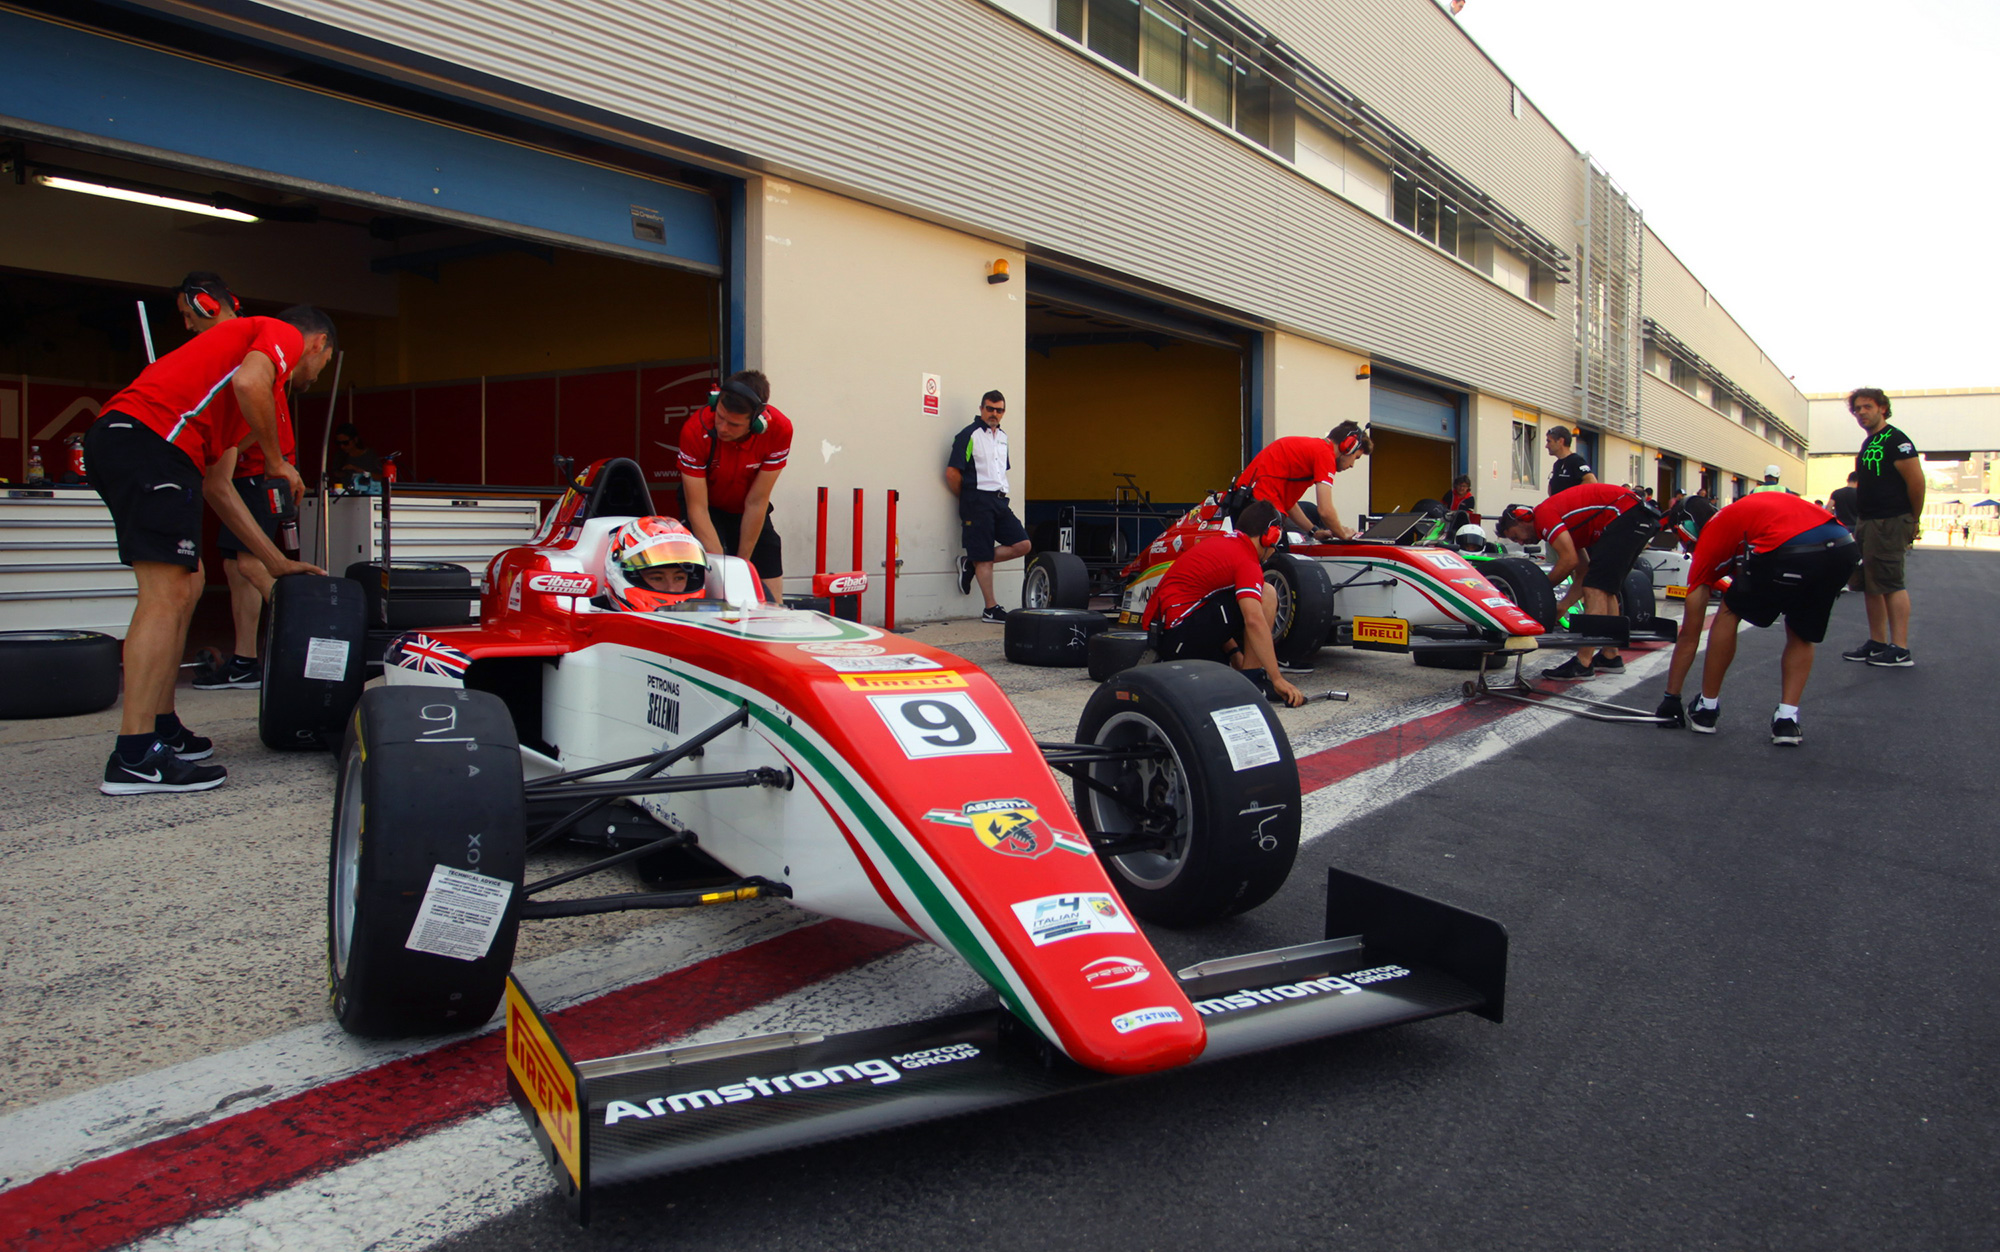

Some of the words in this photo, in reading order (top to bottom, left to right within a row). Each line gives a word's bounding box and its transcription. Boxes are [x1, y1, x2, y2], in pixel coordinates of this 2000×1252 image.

[1061, 530, 1071, 551] 74
[1428, 555, 1462, 568] 74
[529, 575, 593, 594] Eibach
[829, 575, 867, 593] Eibach
[1358, 621, 1404, 640] PIRELLI
[647, 675, 680, 697] PETRONAS
[852, 674, 953, 687] PIRELLI
[647, 692, 680, 736] SELENIA
[901, 700, 977, 747] 9
[966, 800, 1028, 813] ABARTH
[448, 869, 479, 882] TECHNICAL
[481, 877, 502, 887] ADVICE
[1034, 896, 1080, 920] F4
[1033, 912, 1080, 928] ITALIAN
[1085, 966, 1148, 982] PREMA
[1341, 964, 1403, 979] MOTOR
[1354, 969, 1411, 985] GROUP
[1192, 976, 1362, 1016] mstrong
[890, 1042, 975, 1064] MOTOR
[901, 1047, 981, 1070] GROUP
[512, 1002, 573, 1155] PIRELLI
[604, 1058, 901, 1125] Armstrong
